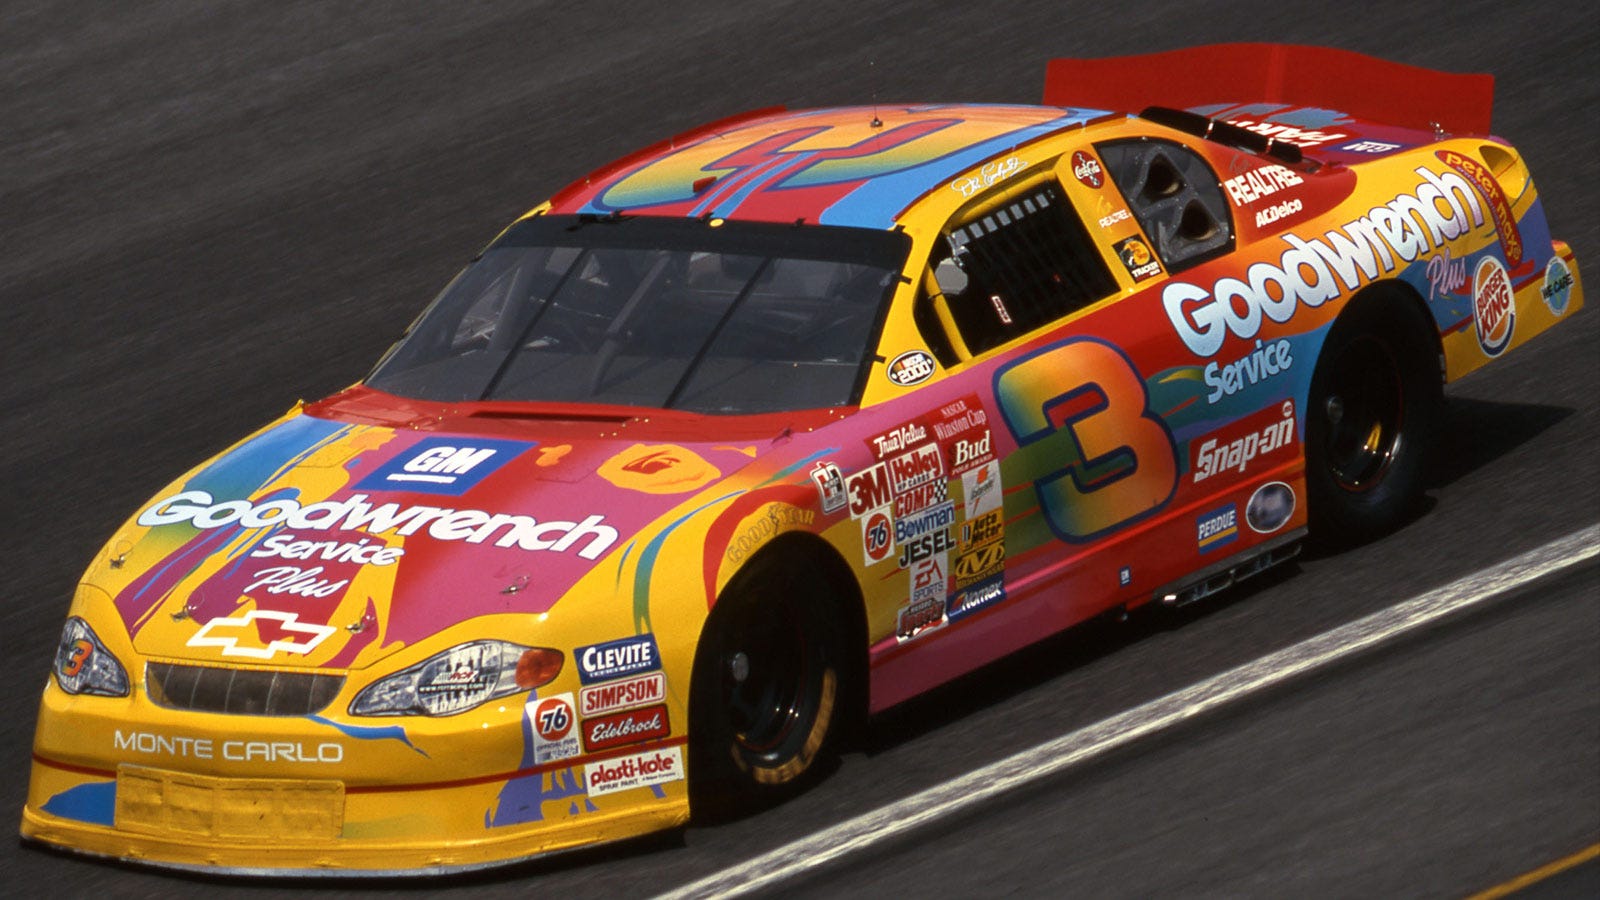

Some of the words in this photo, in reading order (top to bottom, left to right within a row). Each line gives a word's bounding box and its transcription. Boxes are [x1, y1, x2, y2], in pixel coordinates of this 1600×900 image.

[1446, 152, 1499, 200] peter
[1162, 166, 1484, 357] Goodwrench
[1426, 247, 1467, 300] Plus
[1476, 268, 1505, 315] BURGER
[1481, 284, 1510, 343] KING
[897, 362, 931, 385] 2000
[1204, 339, 1293, 404] Service
[933, 416, 969, 441] Winston
[967, 409, 987, 431] Cup
[992, 335, 1181, 545] 3
[403, 446, 497, 475] GM
[892, 448, 943, 483] Holley
[954, 431, 991, 467] Bud
[1194, 417, 1294, 483] Snap-on
[849, 466, 892, 516] 3M
[895, 483, 935, 519] COMP
[137, 490, 619, 561] Goodwrench
[726, 502, 815, 564] GOODYEAR
[867, 518, 887, 552] 76
[895, 505, 955, 541] Bowman
[1198, 510, 1237, 540] PERDUE
[250, 534, 404, 566] Service
[900, 527, 956, 568] JESEL
[243, 566, 350, 598] Plus
[913, 581, 944, 601] SPORTS
[61, 639, 94, 677] 3
[582, 642, 651, 673] CLEVITE
[586, 678, 659, 712] SIMPSON
[540, 704, 567, 735] 76
[590, 712, 662, 743] Edelbrock
[114, 730, 213, 760] MONTE
[222, 741, 344, 763] CARLO
[590, 753, 674, 788] plasti-kote
[620, 777, 639, 788] PAINT
